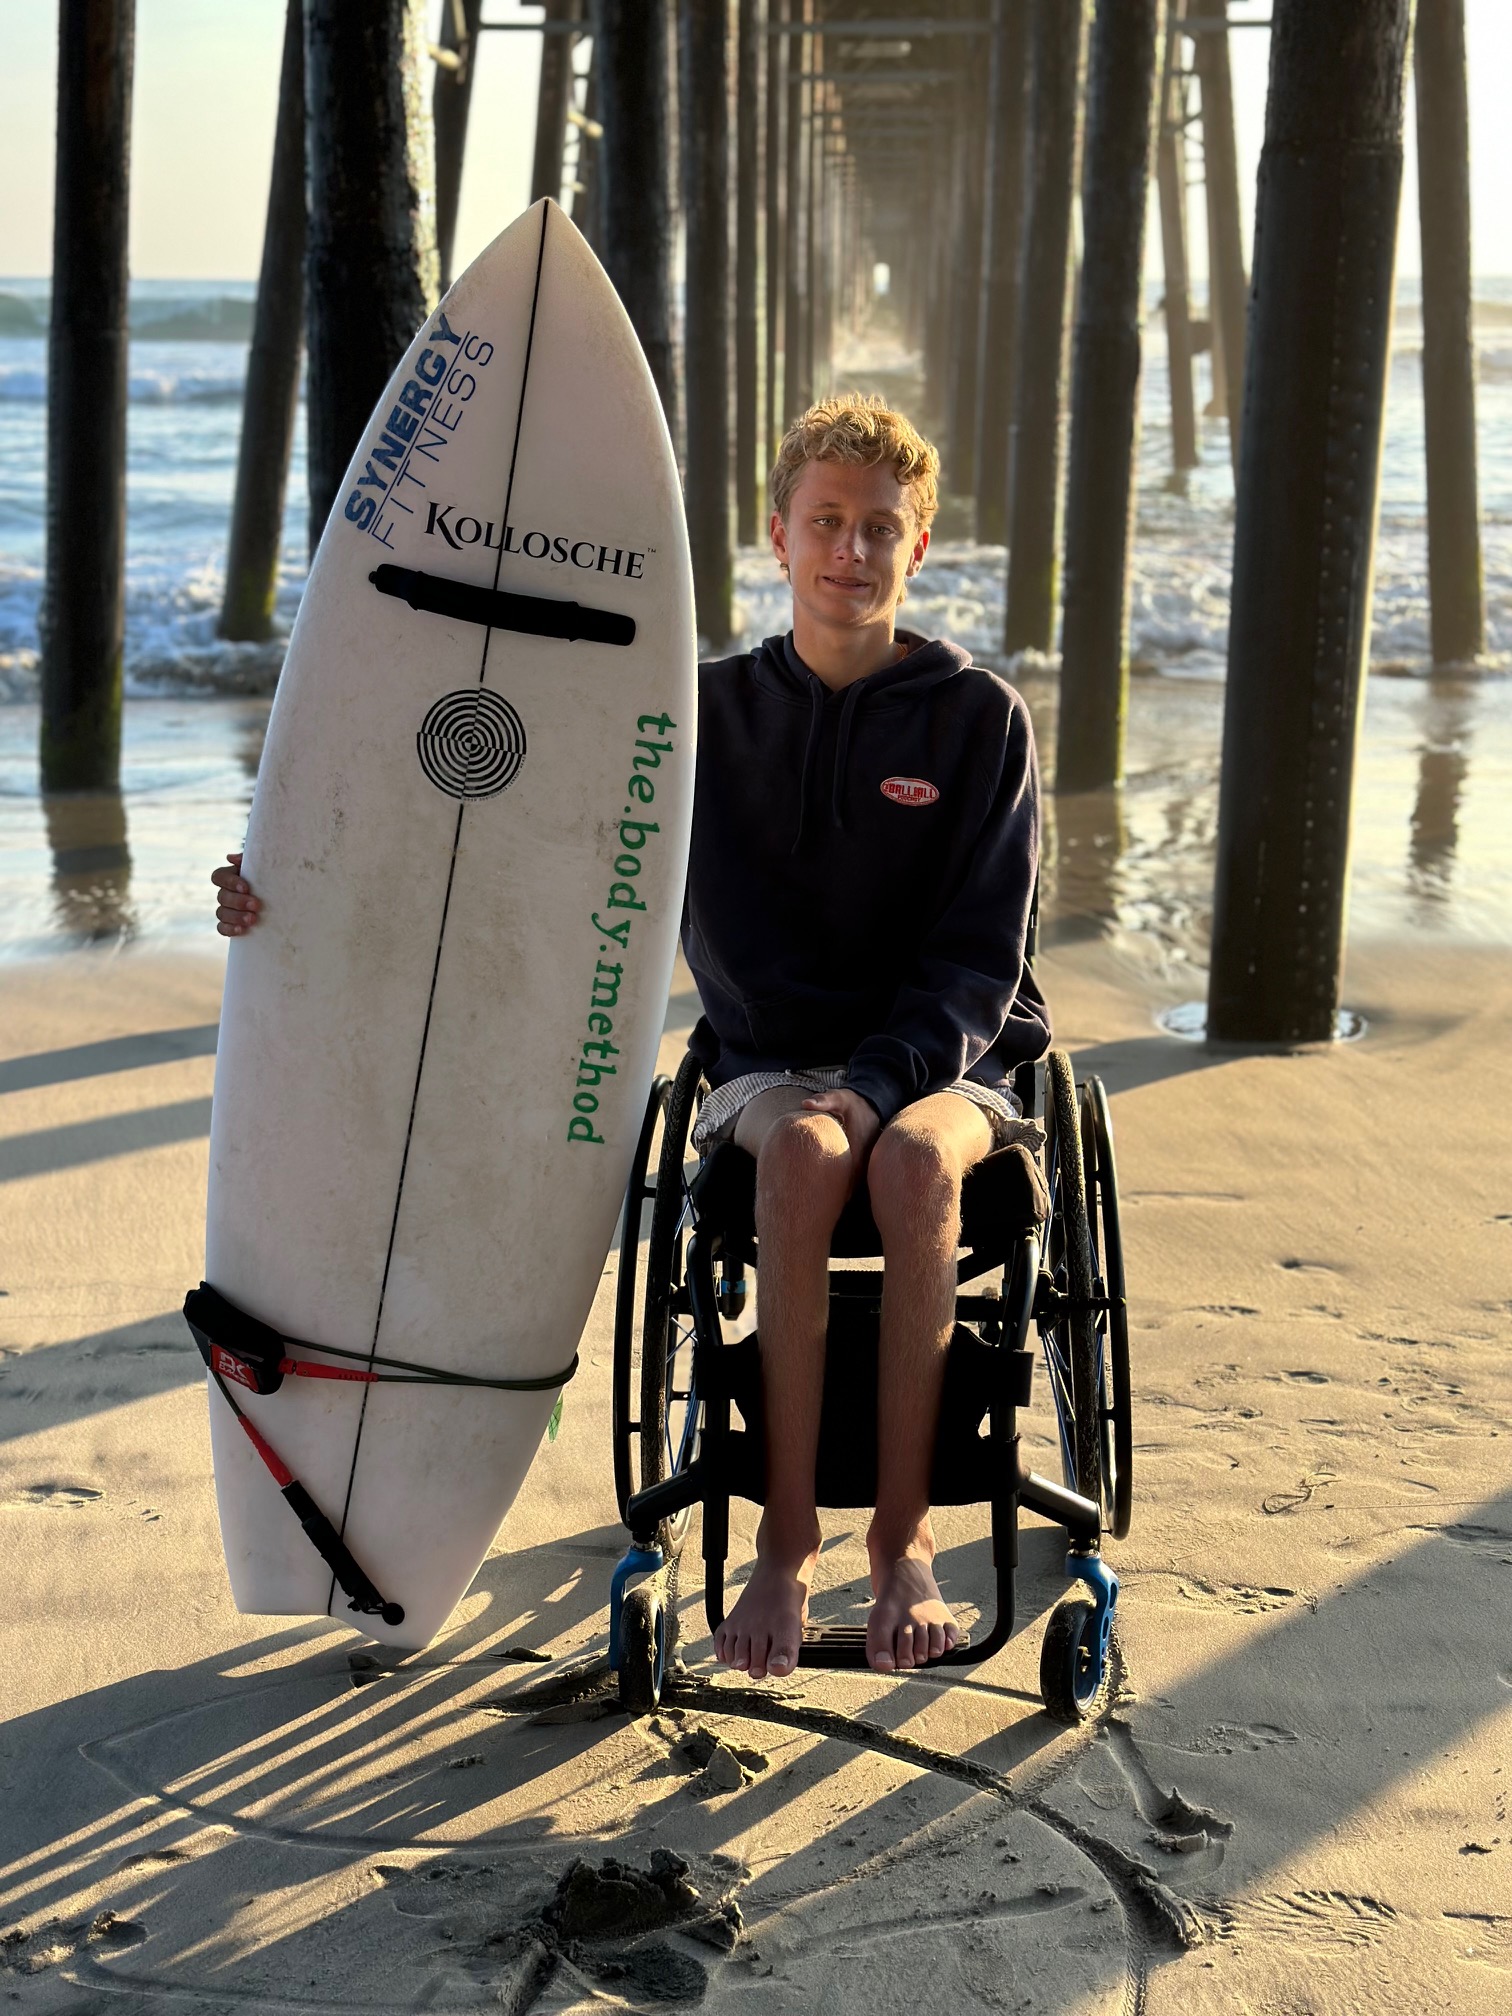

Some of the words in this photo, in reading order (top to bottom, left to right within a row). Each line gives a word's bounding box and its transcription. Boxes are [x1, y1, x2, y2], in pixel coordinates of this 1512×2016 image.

[344, 312, 462, 531] SYNERGY
[371, 335, 494, 550] FITNESS
[424, 501, 645, 579] KOLLOSCHE
[567, 712, 678, 1145] the.body.method
